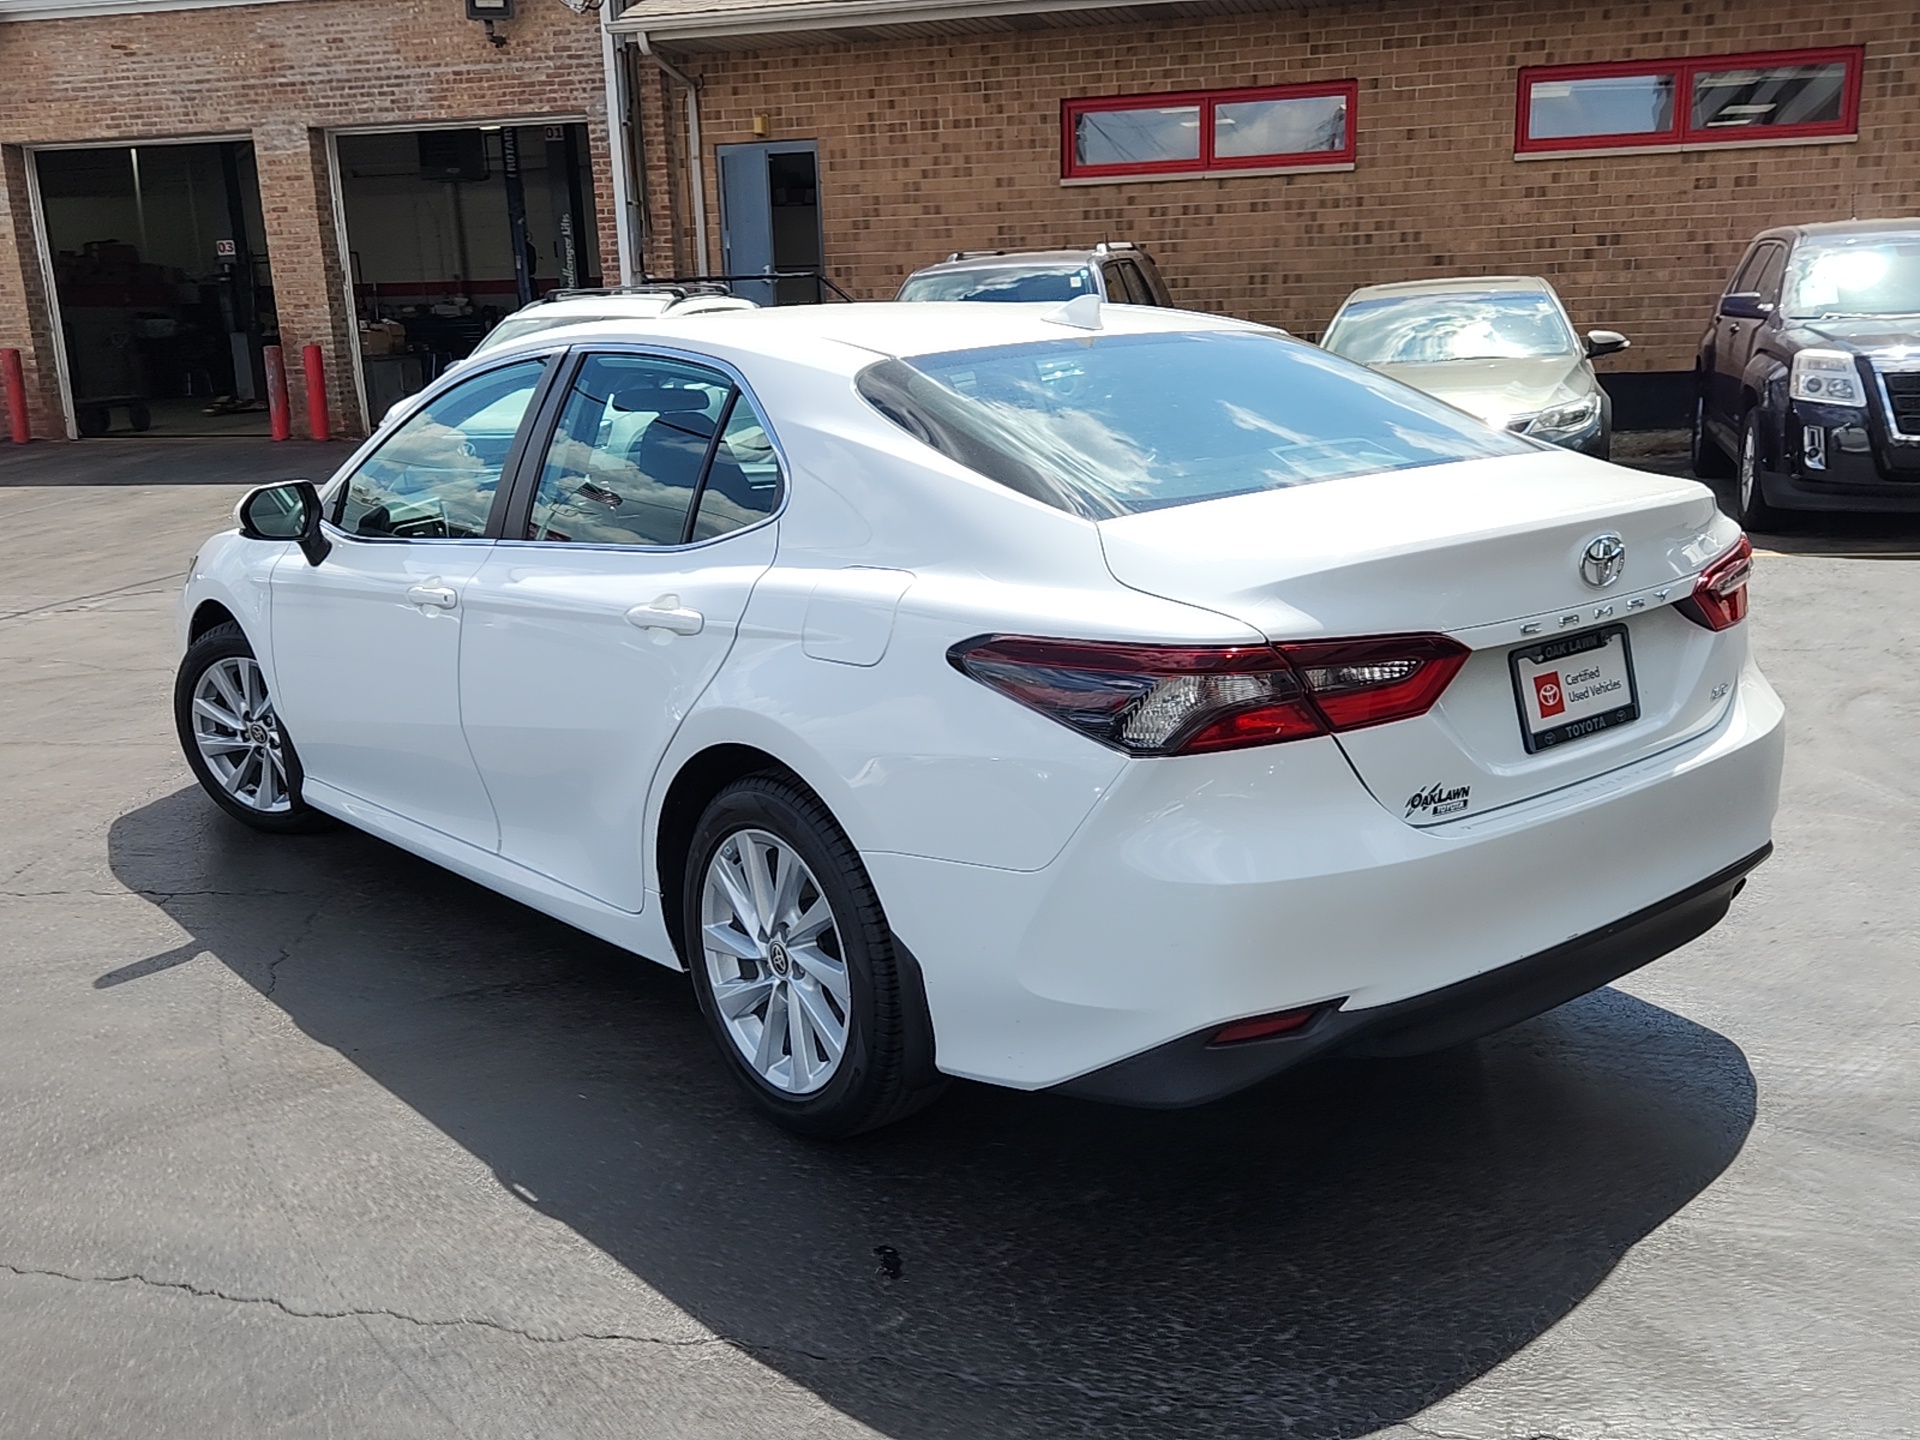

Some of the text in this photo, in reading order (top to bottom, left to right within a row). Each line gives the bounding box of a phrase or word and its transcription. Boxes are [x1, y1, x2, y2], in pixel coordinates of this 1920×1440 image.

[547, 127, 562, 138] 01
[218, 242, 234, 253] 03
[1519, 588, 1671, 635] CAMRY
[1545, 634, 1598, 658] OAK LAWN
[1565, 666, 1600, 686] Certified
[1568, 679, 1622, 702] Used Vehicles
[1565, 716, 1607, 739] TOYOTA
